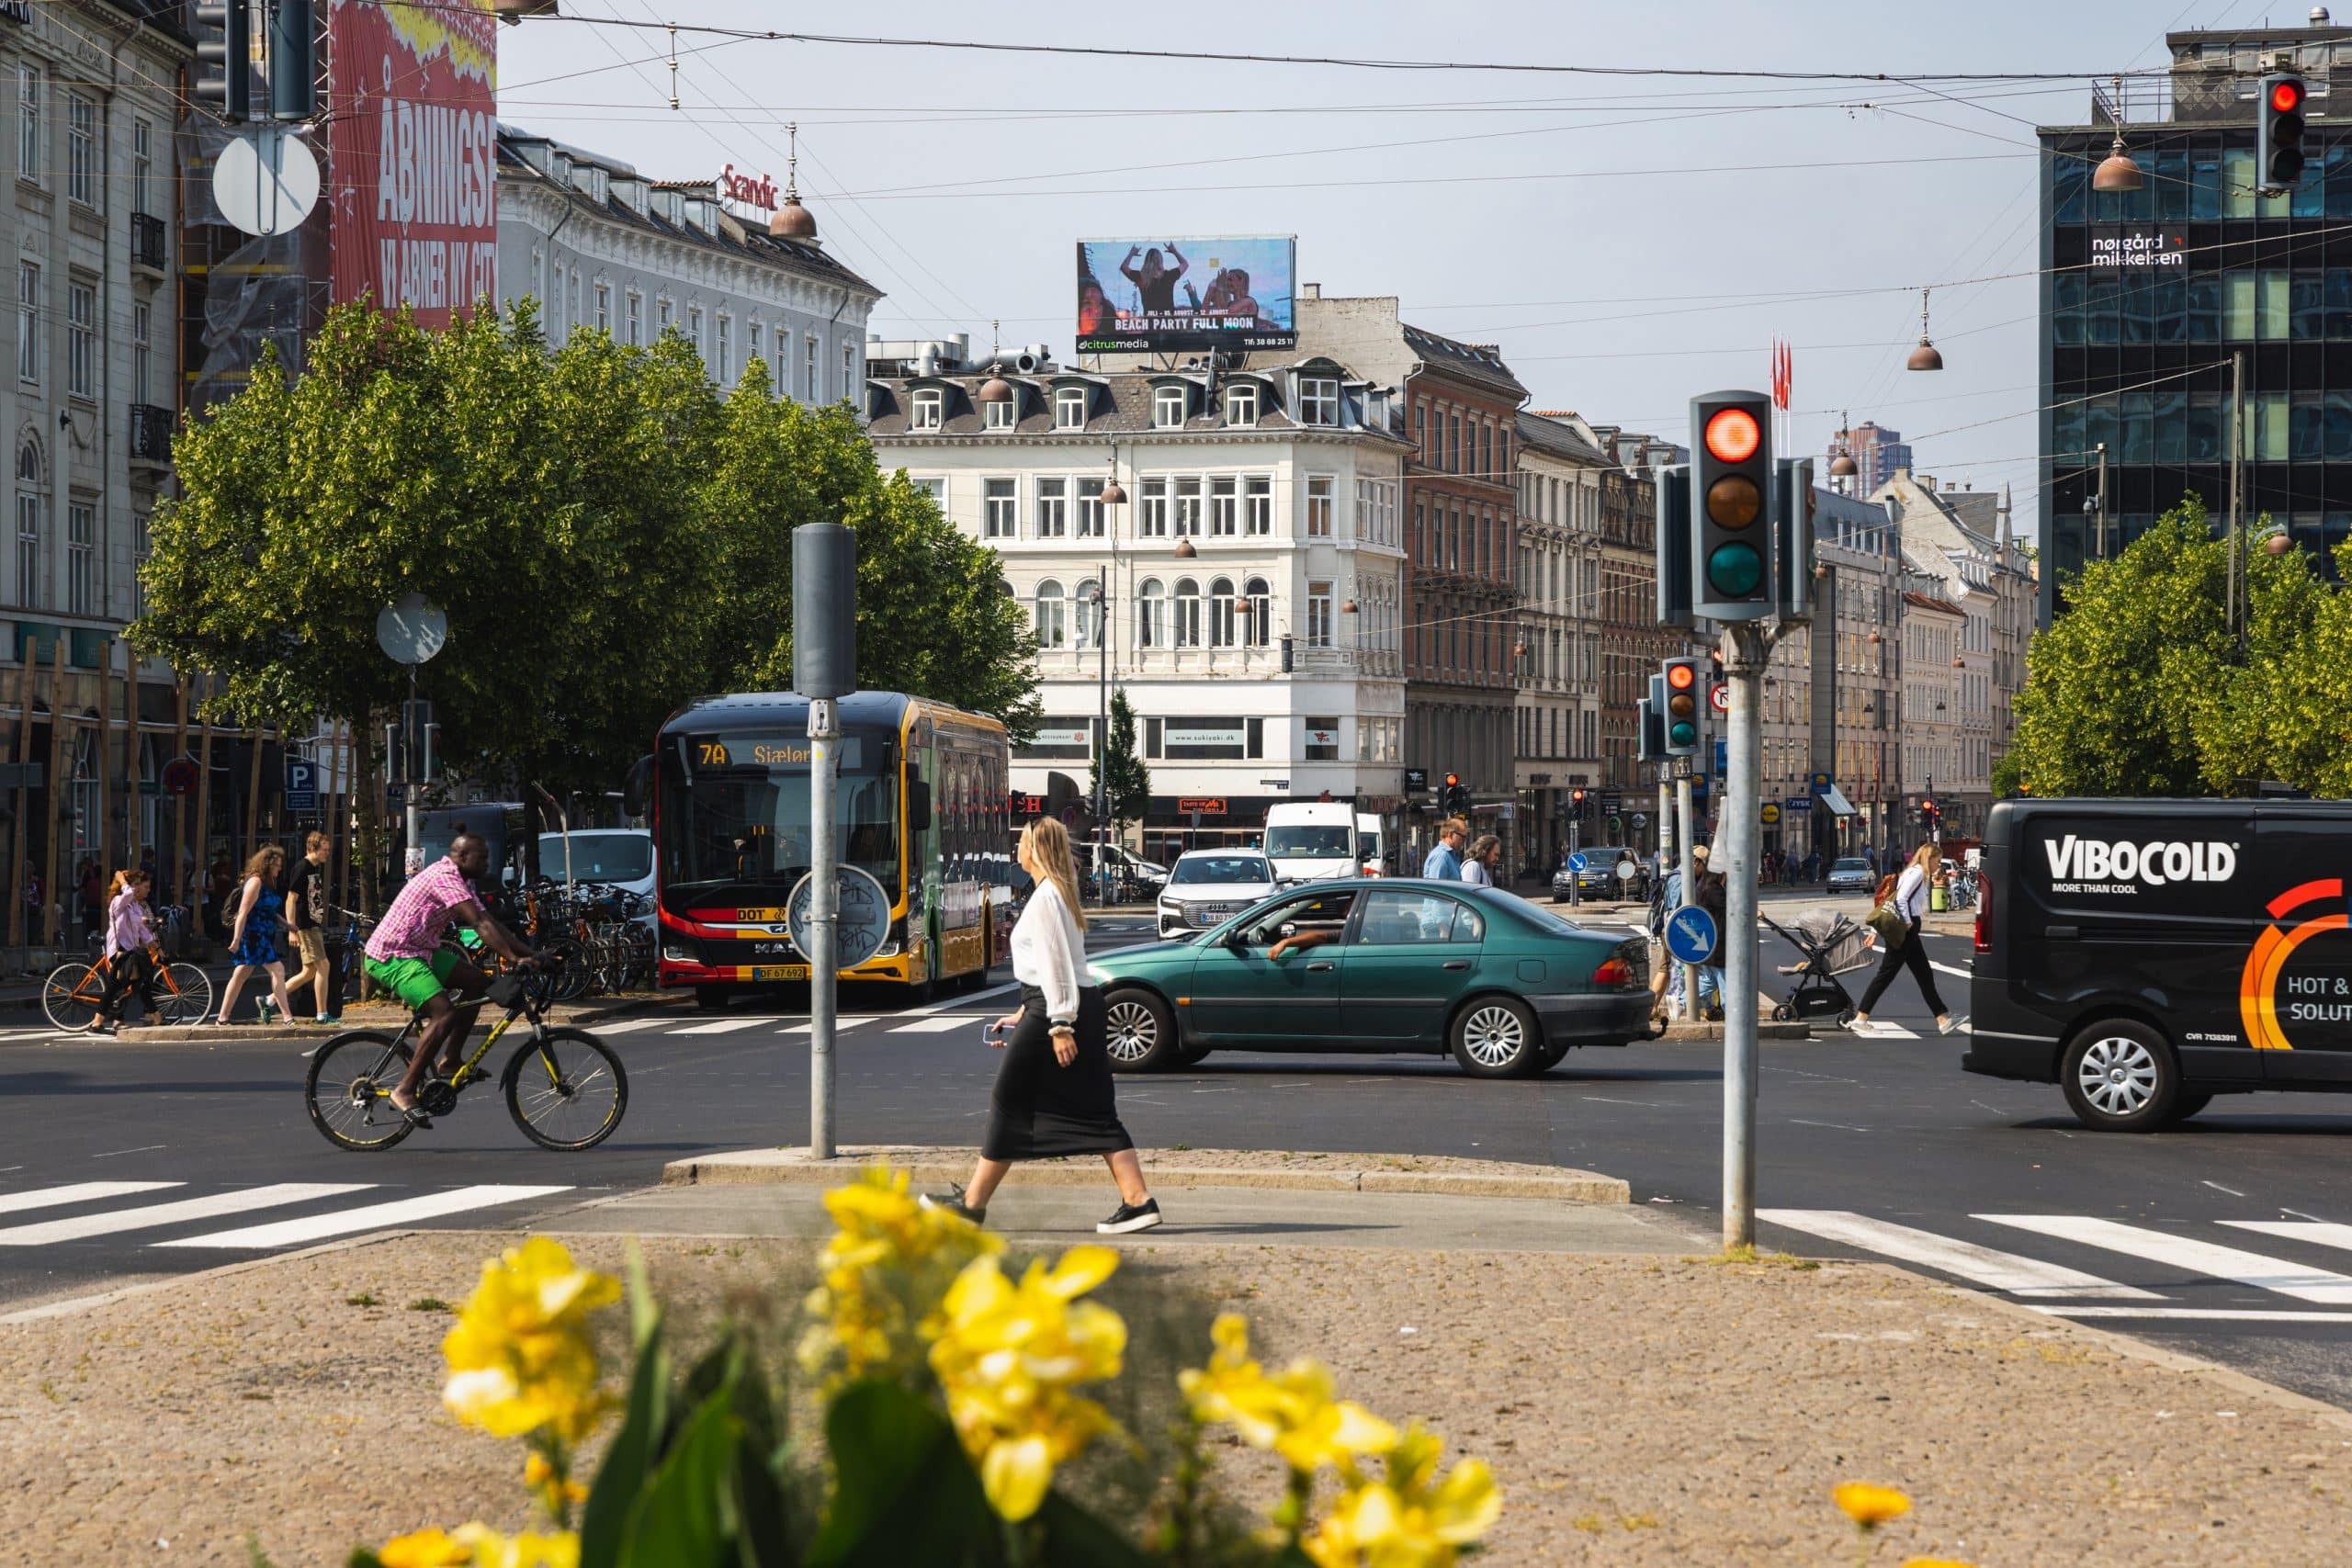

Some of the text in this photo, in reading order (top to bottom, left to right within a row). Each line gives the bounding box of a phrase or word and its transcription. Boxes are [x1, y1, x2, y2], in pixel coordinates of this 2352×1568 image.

[722, 163, 779, 211] Scandic
[2093, 232, 2164, 251] nørgård
[2092, 250, 2182, 265] mikkelsen
[450, 242, 468, 309] NY
[1114, 317, 1254, 331] BEACH PARTY FULL MOON
[1087, 339, 1149, 349] citrusmedia
[698, 744, 726, 765] 7A
[292, 765, 309, 788] P
[2044, 834, 2236, 886] VIBOCOLD
[2052, 884, 2138, 894] MORE THAN COOL
[738, 909, 764, 920] DOT
[761, 968, 803, 978] DF 67 692
[2288, 977, 2349, 995] HOT &
